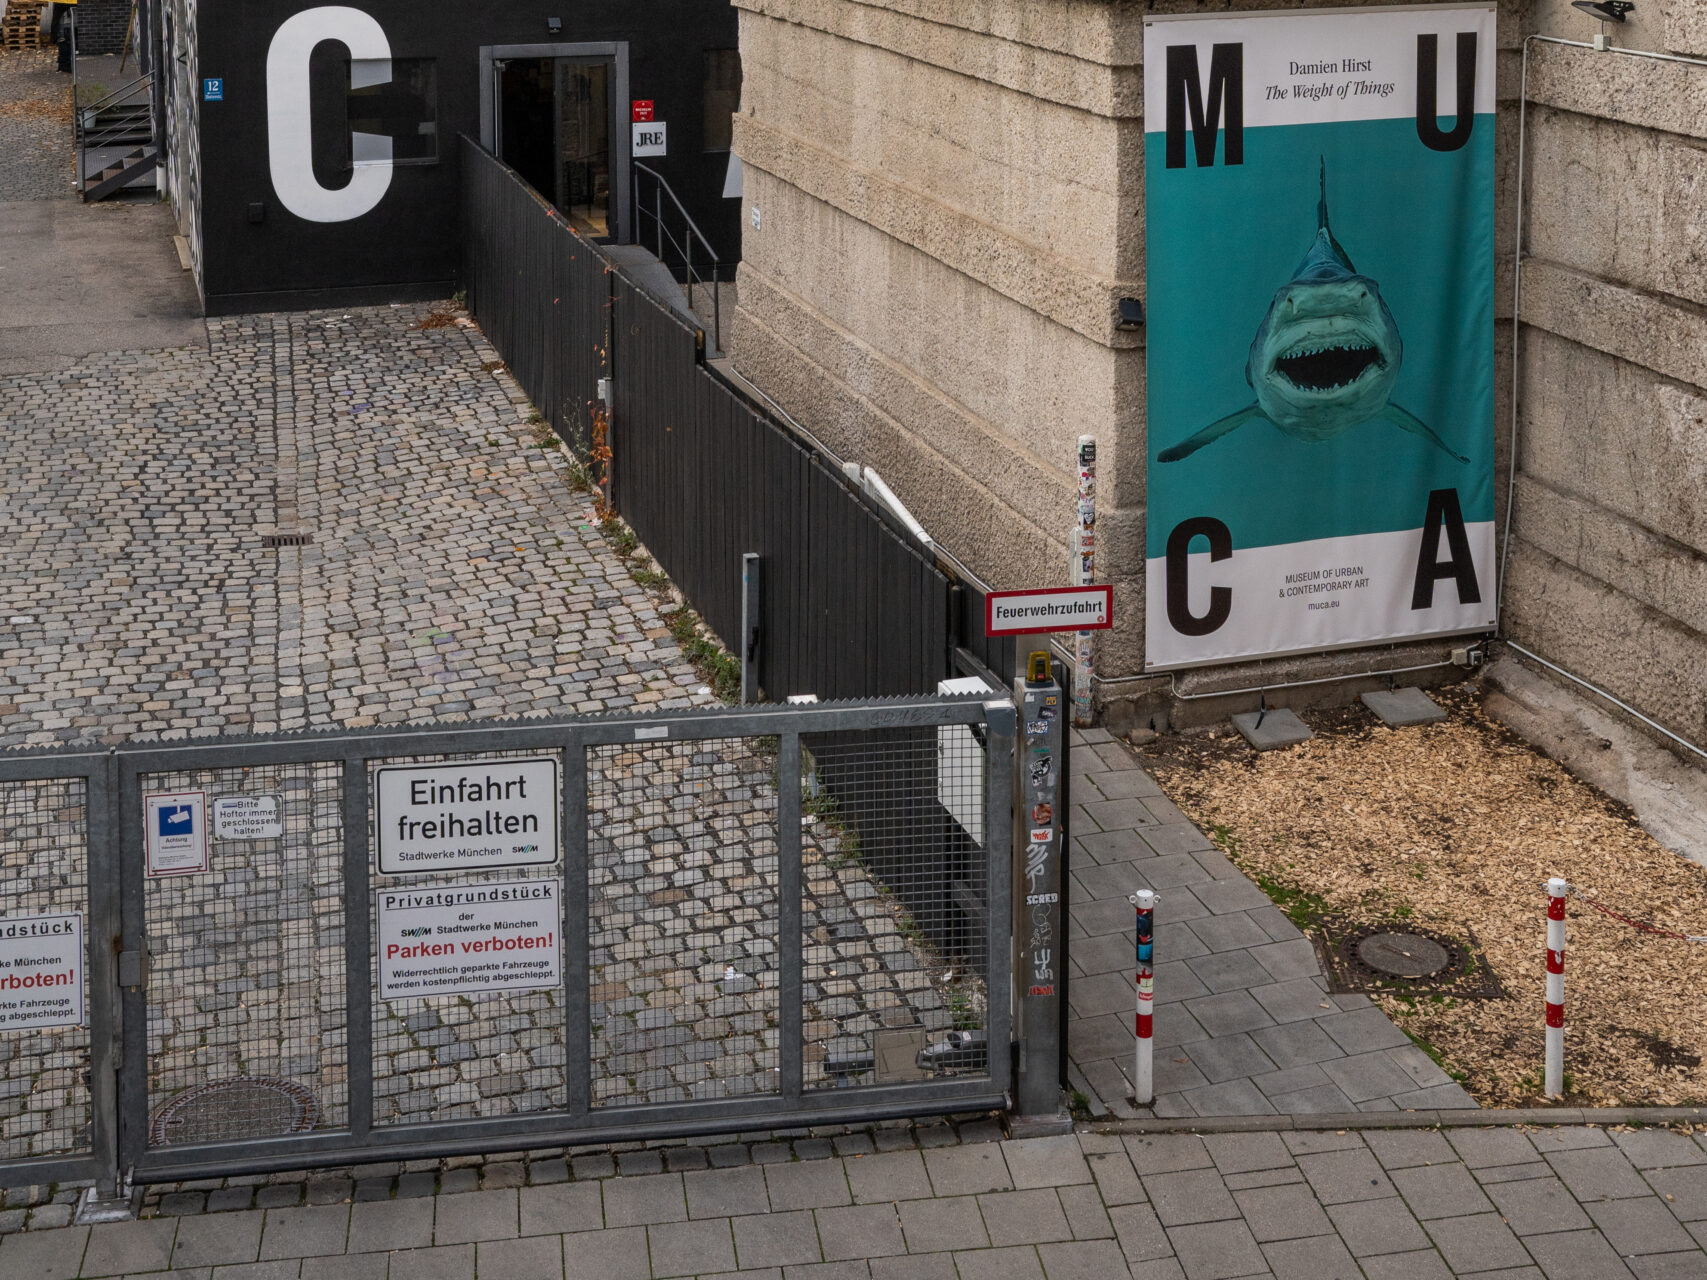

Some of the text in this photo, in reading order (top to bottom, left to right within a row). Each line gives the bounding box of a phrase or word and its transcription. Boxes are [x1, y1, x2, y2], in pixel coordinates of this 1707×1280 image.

[1289, 58, 1372, 75] Damien Hirst
[208, 80, 219, 92] 12
[1266, 80, 1395, 101] The Weight of Things
[1165, 32, 1476, 169] M U
[266, 5, 394, 223] C
[636, 131, 664, 147] JRE
[1165, 488, 1482, 637] C A
[1285, 566, 1364, 584] MUSEUM OF URBAN
[1279, 578, 1370, 598] & CONTEMPORARY ART
[996, 601, 1103, 619] Feuerwehrzufahrt
[1308, 600, 1340, 610] muca.eu
[411, 775, 527, 806] Einfahrt
[237, 800, 259, 808] Bitte
[220, 809, 277, 819] Hoftor immer
[221, 818, 276, 829] geschlossen
[233, 827, 264, 835] halten!
[398, 810, 538, 841] freihalten
[399, 850, 455, 862] Stadtwerke
[457, 847, 503, 858] München
[386, 885, 552, 909] Privatgrundstück
[458, 912, 475, 921] der
[436, 924, 491, 935] Stadtwerke
[493, 920, 539, 930] München
[387, 932, 553, 960] Parken verboten!
[14, 956, 62, 967] München
[392, 960, 550, 978] Widerrechtlich geparkte Fahrzeuge
[387, 970, 556, 990] werden kostenpflichtig abgeschleppt.
[20, 998, 70, 1009] Fahrzeuge
[8, 1008, 76, 1021] abgeschleppt.
